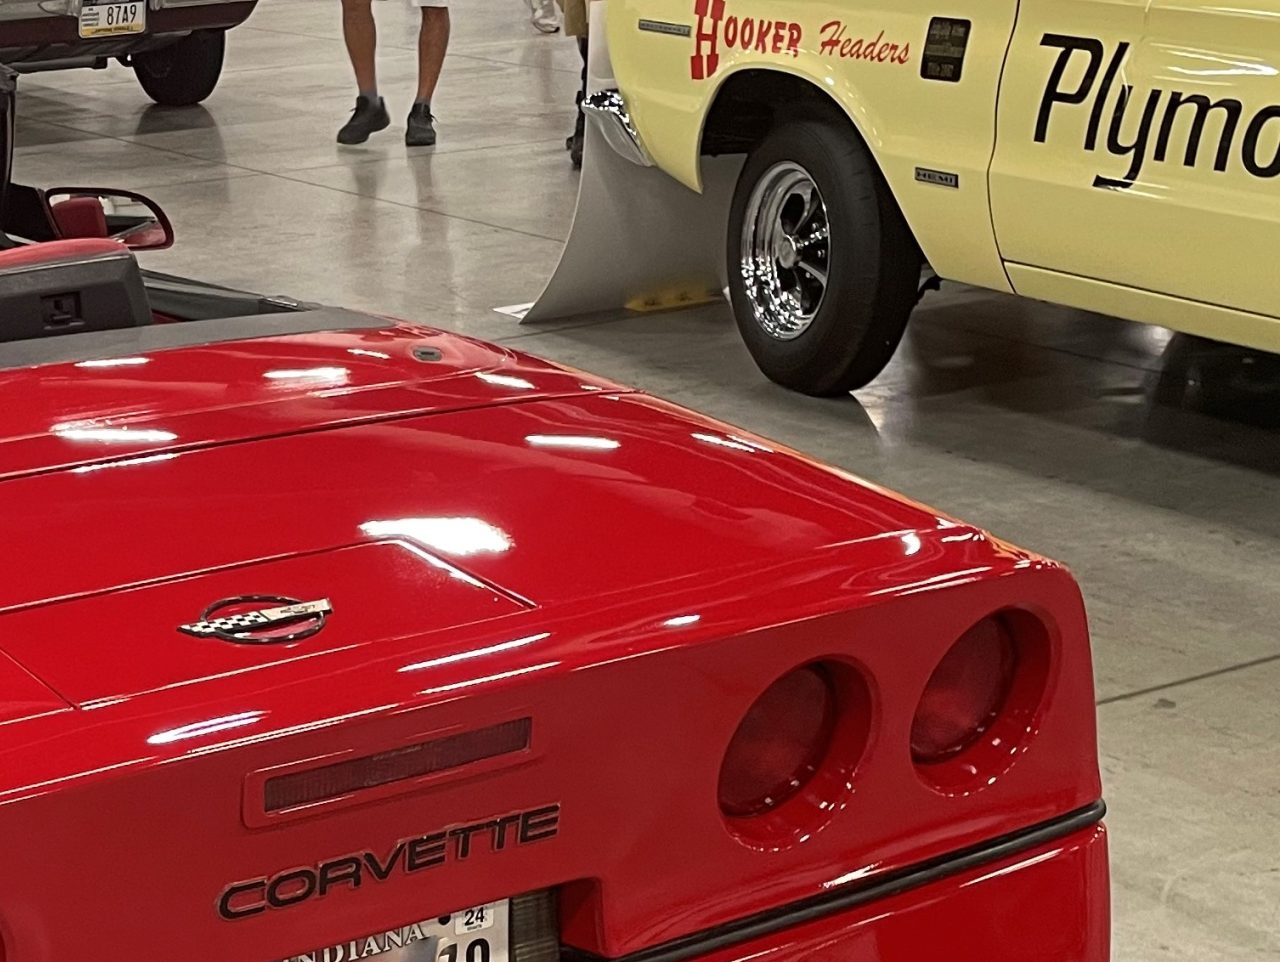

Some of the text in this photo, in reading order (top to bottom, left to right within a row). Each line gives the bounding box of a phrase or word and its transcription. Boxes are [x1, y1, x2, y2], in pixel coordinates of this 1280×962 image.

[107, 4, 137, 25] 87A9
[690, 0, 802, 80] HOOKER
[820, 20, 909, 65] Headers
[1033, 33, 1280, 190] Plymo
[216, 801, 561, 920] CORVETTE
[464, 906, 485, 926] 24
